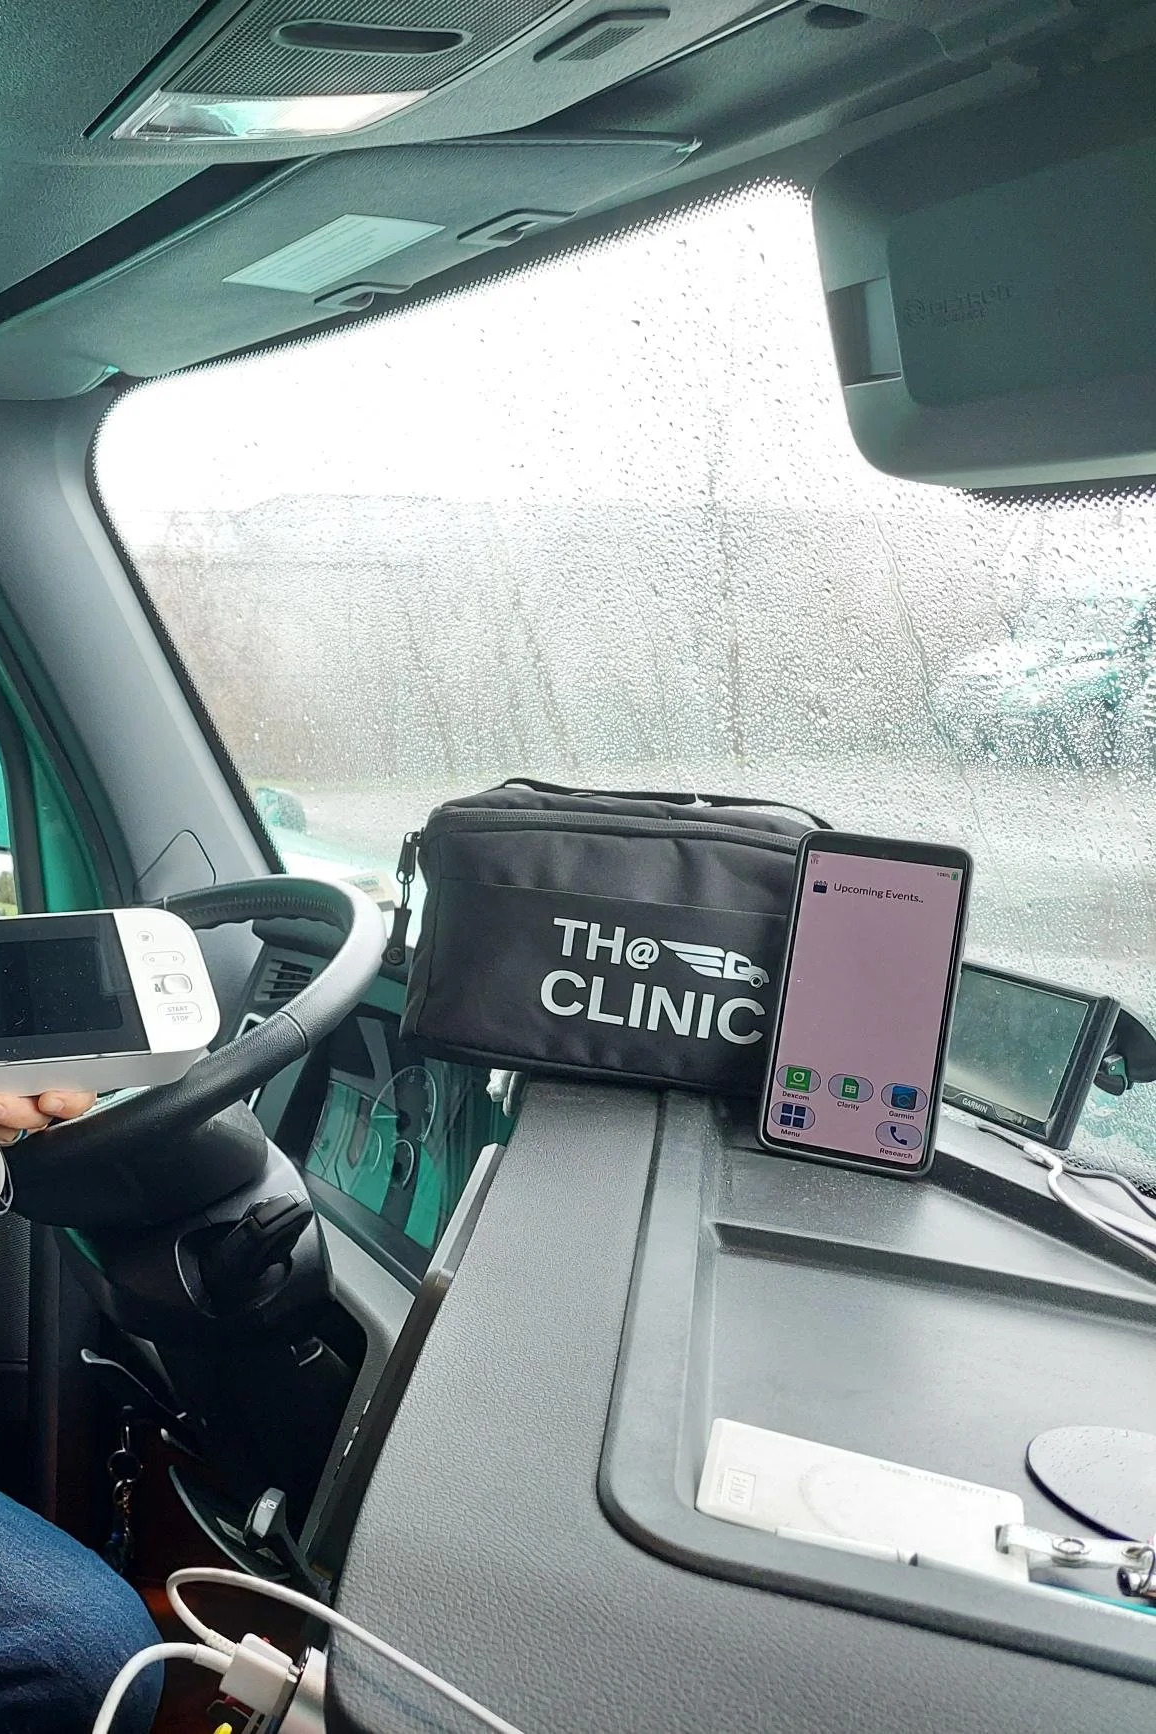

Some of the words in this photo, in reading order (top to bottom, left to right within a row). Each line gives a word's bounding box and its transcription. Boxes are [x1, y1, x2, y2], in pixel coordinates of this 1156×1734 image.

[833, 882, 884, 899] Upcoming
[553, 917, 660, 970] TH@
[166, 1005, 189, 1013] START
[540, 969, 766, 1046] CLINIC
[171, 1014, 189, 1022] STOP
[782, 1090, 810, 1102] Dexcom
[836, 1100, 860, 1112] Clarity
[962, 1097, 988, 1114] GARMIN
[888, 1110, 915, 1121] Garmin
[780, 1128, 801, 1138] Menu
[879, 1147, 913, 1160] Research
